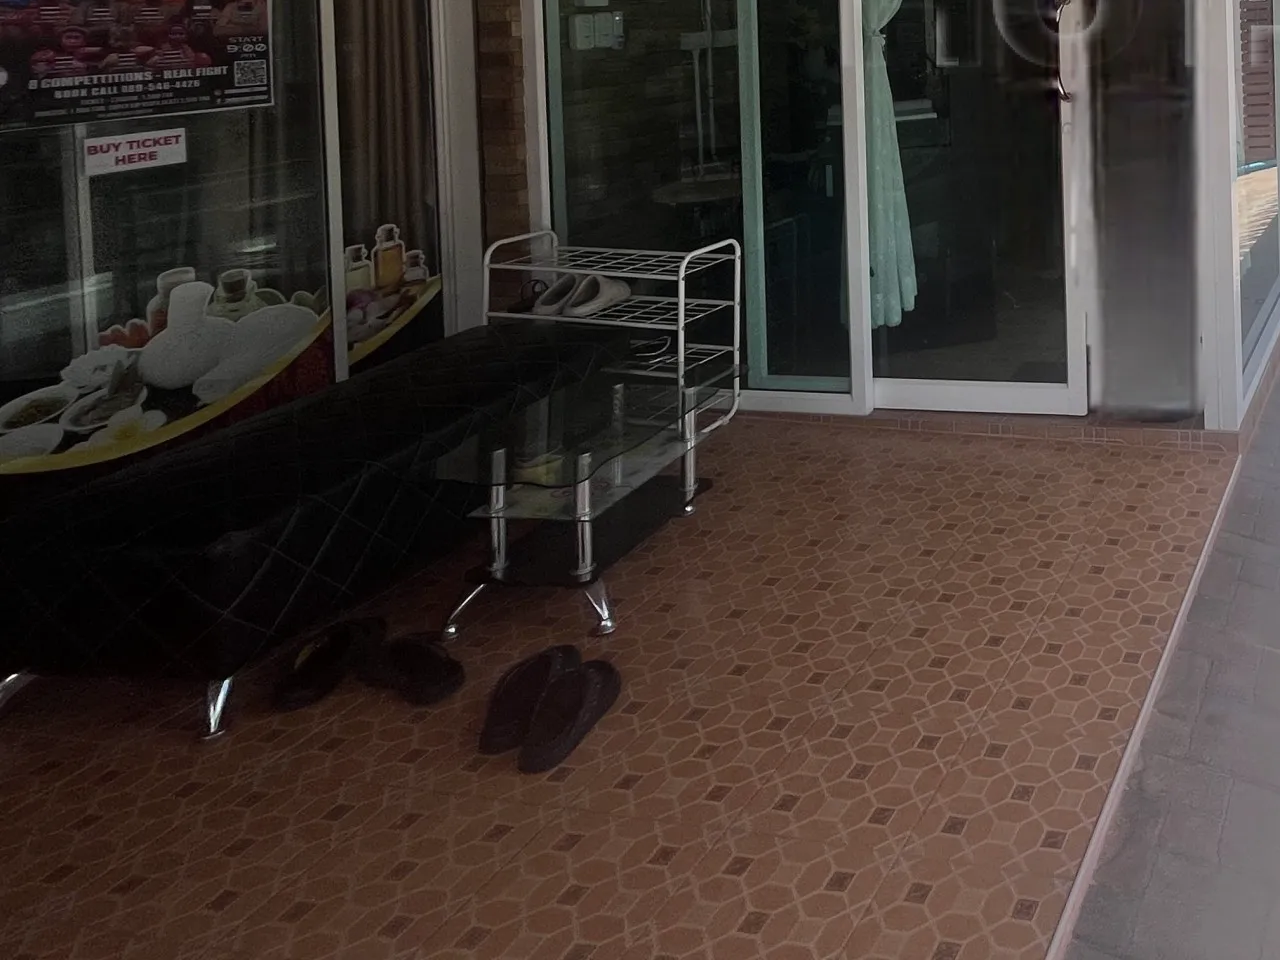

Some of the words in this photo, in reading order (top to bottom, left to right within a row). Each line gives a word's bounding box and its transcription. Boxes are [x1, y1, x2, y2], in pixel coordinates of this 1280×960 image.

[226, 43, 267, 53] 9:00
[163, 68, 193, 79] REAL
[196, 65, 228, 77] FIGHT
[91, 86, 118, 96] CALL
[87, 141, 123, 156] BUY
[126, 134, 182, 149] TICKET
[115, 151, 158, 166] HERE
